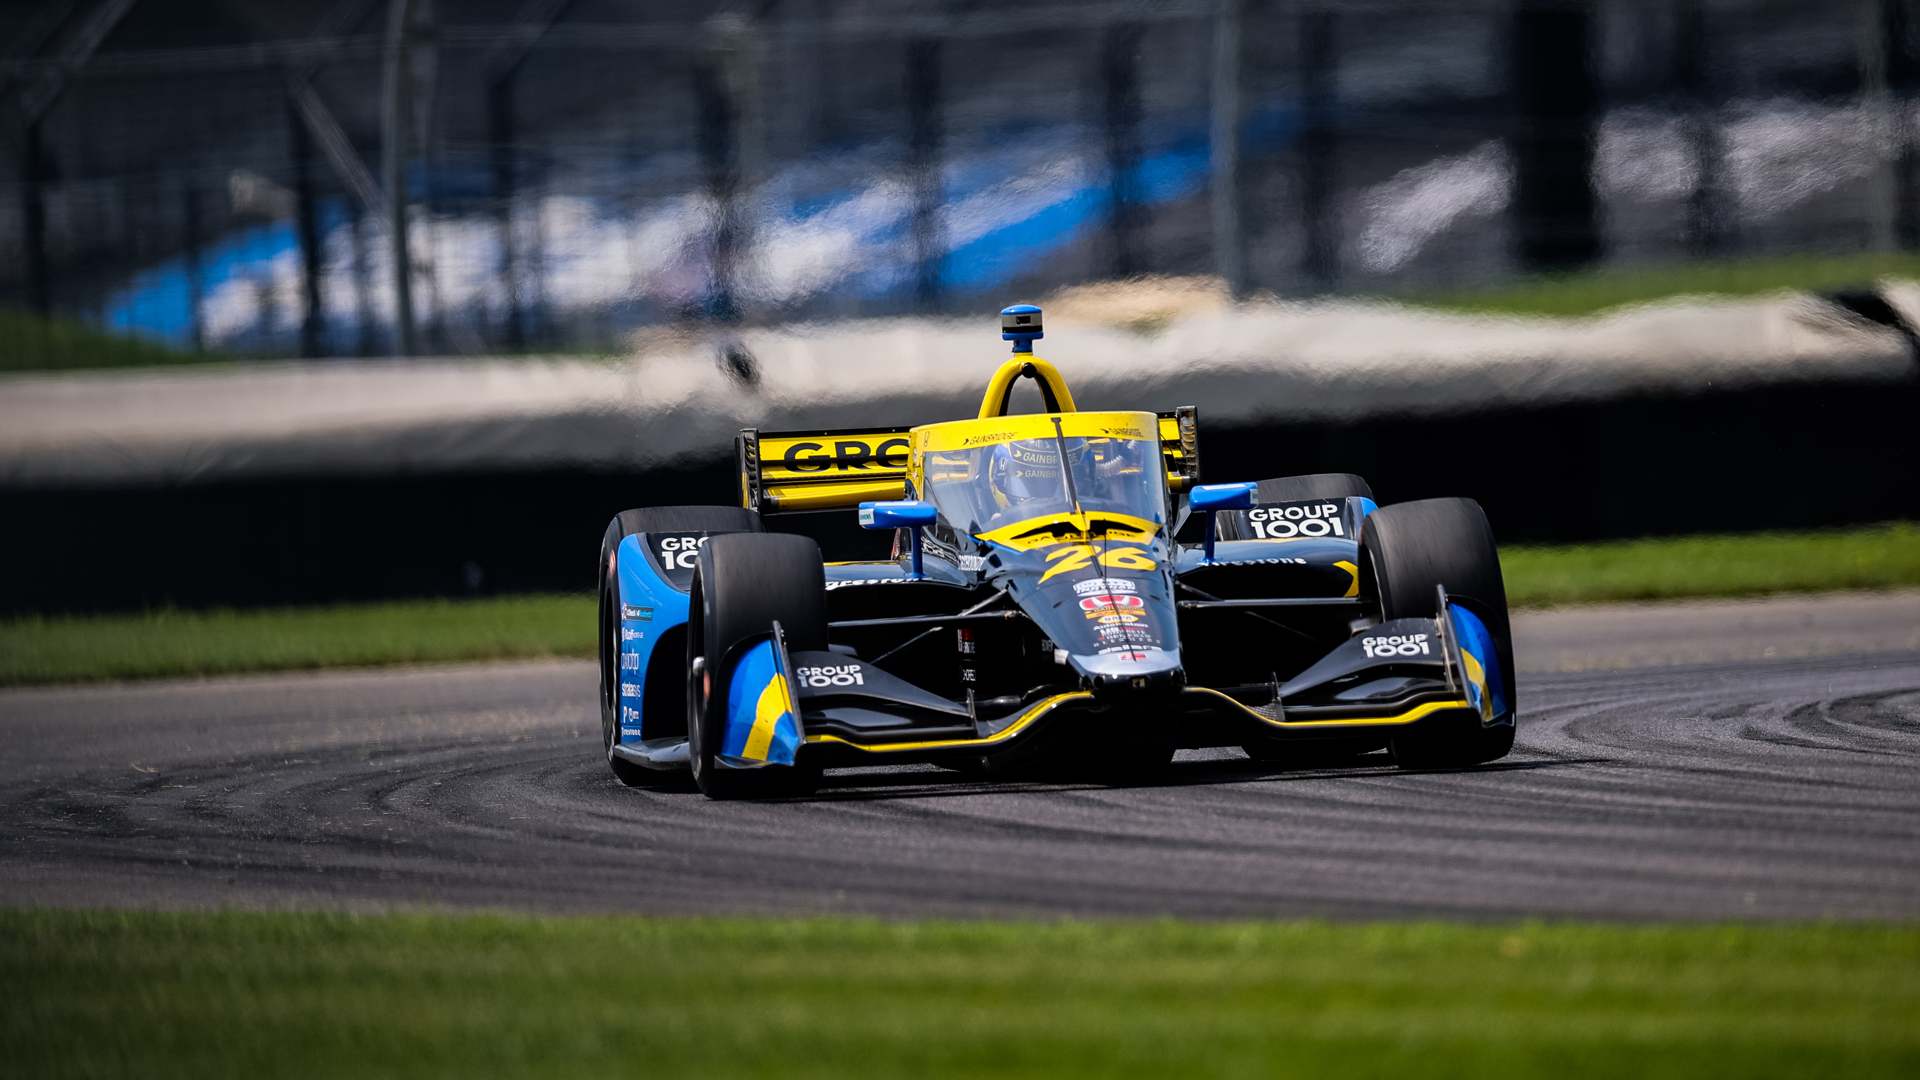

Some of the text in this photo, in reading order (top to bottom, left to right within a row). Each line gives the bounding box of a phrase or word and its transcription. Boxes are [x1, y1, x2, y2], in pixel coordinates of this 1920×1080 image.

[970, 432, 1018, 445] GAINBRIDGE
[784, 438, 910, 473] GRO
[1249, 504, 1338, 521] GROUP
[1250, 517, 1344, 539] 1001
[661, 550, 699, 570] 10
[1038, 545, 1156, 584] 26
[1362, 633, 1428, 647] GROUP
[1363, 641, 1430, 658] 1001
[797, 664, 861, 677] GROUP
[799, 673, 864, 688] 1001
